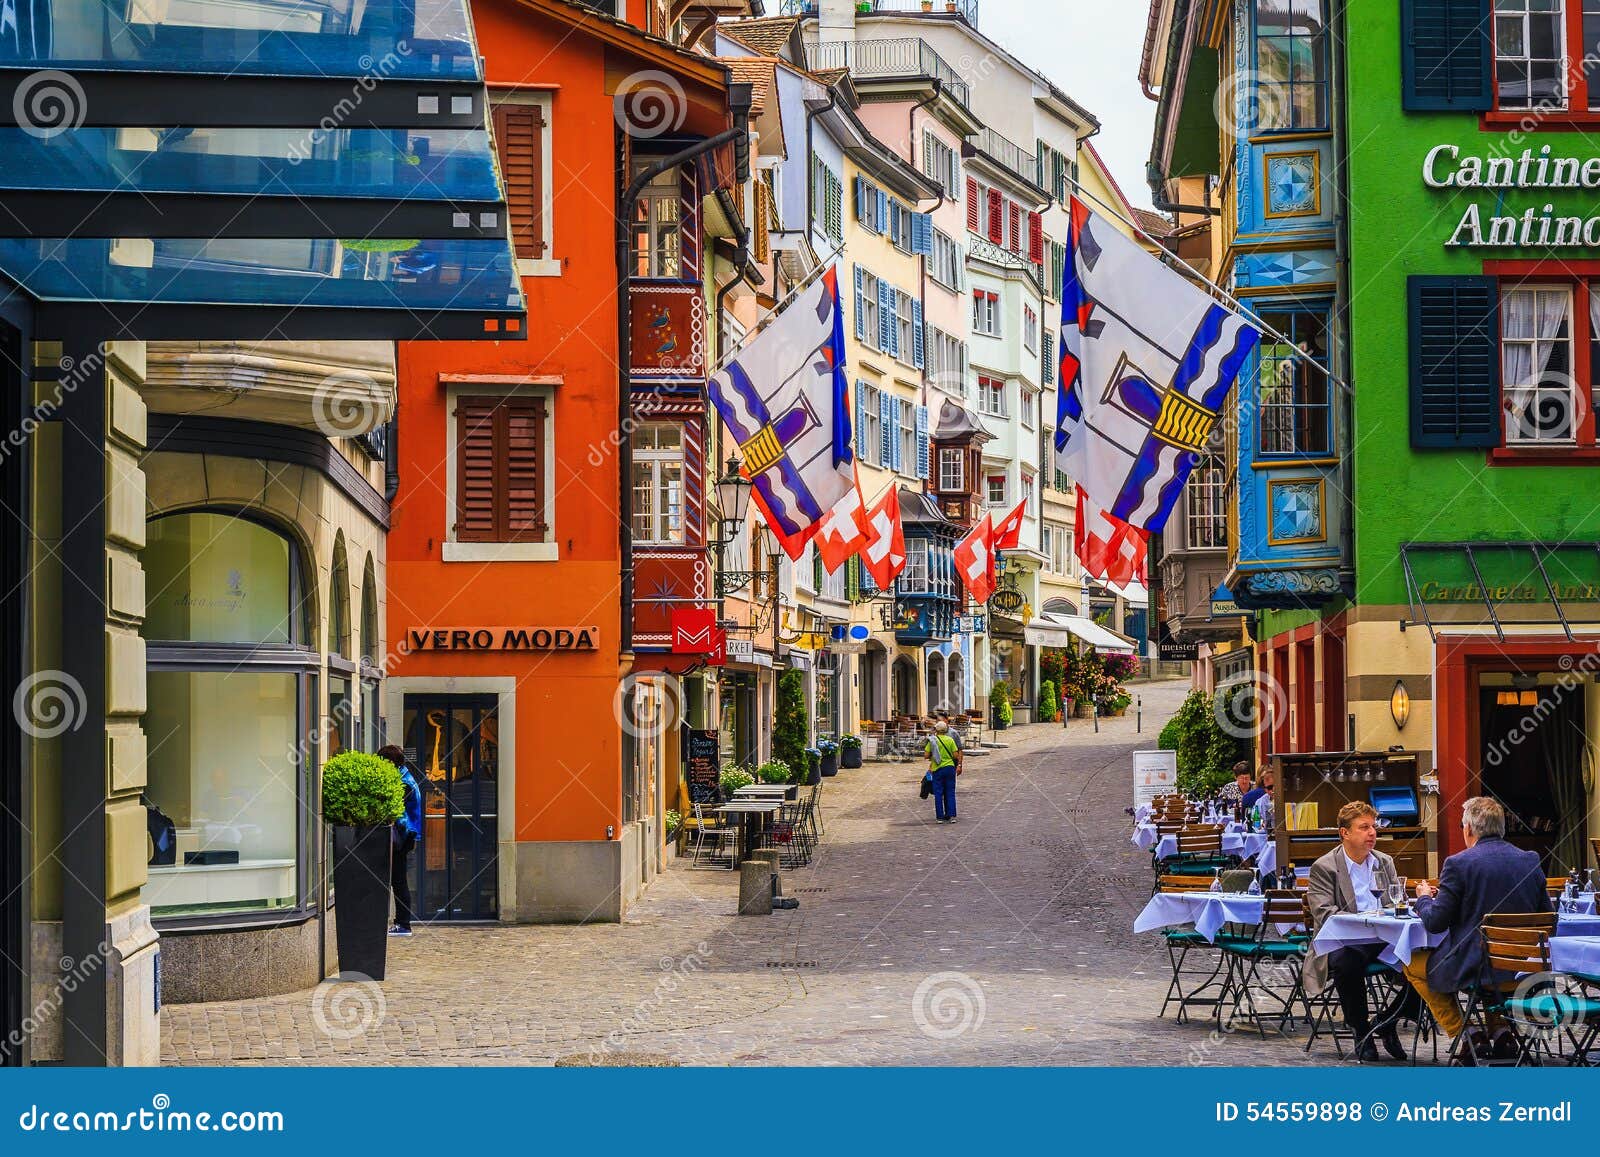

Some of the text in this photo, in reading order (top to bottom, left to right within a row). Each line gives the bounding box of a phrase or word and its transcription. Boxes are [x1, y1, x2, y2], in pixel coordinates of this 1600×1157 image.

[1422, 144, 1600, 188] Cantine
[1444, 203, 1600, 247] Antino
[411, 629, 594, 649] VERO MODA
